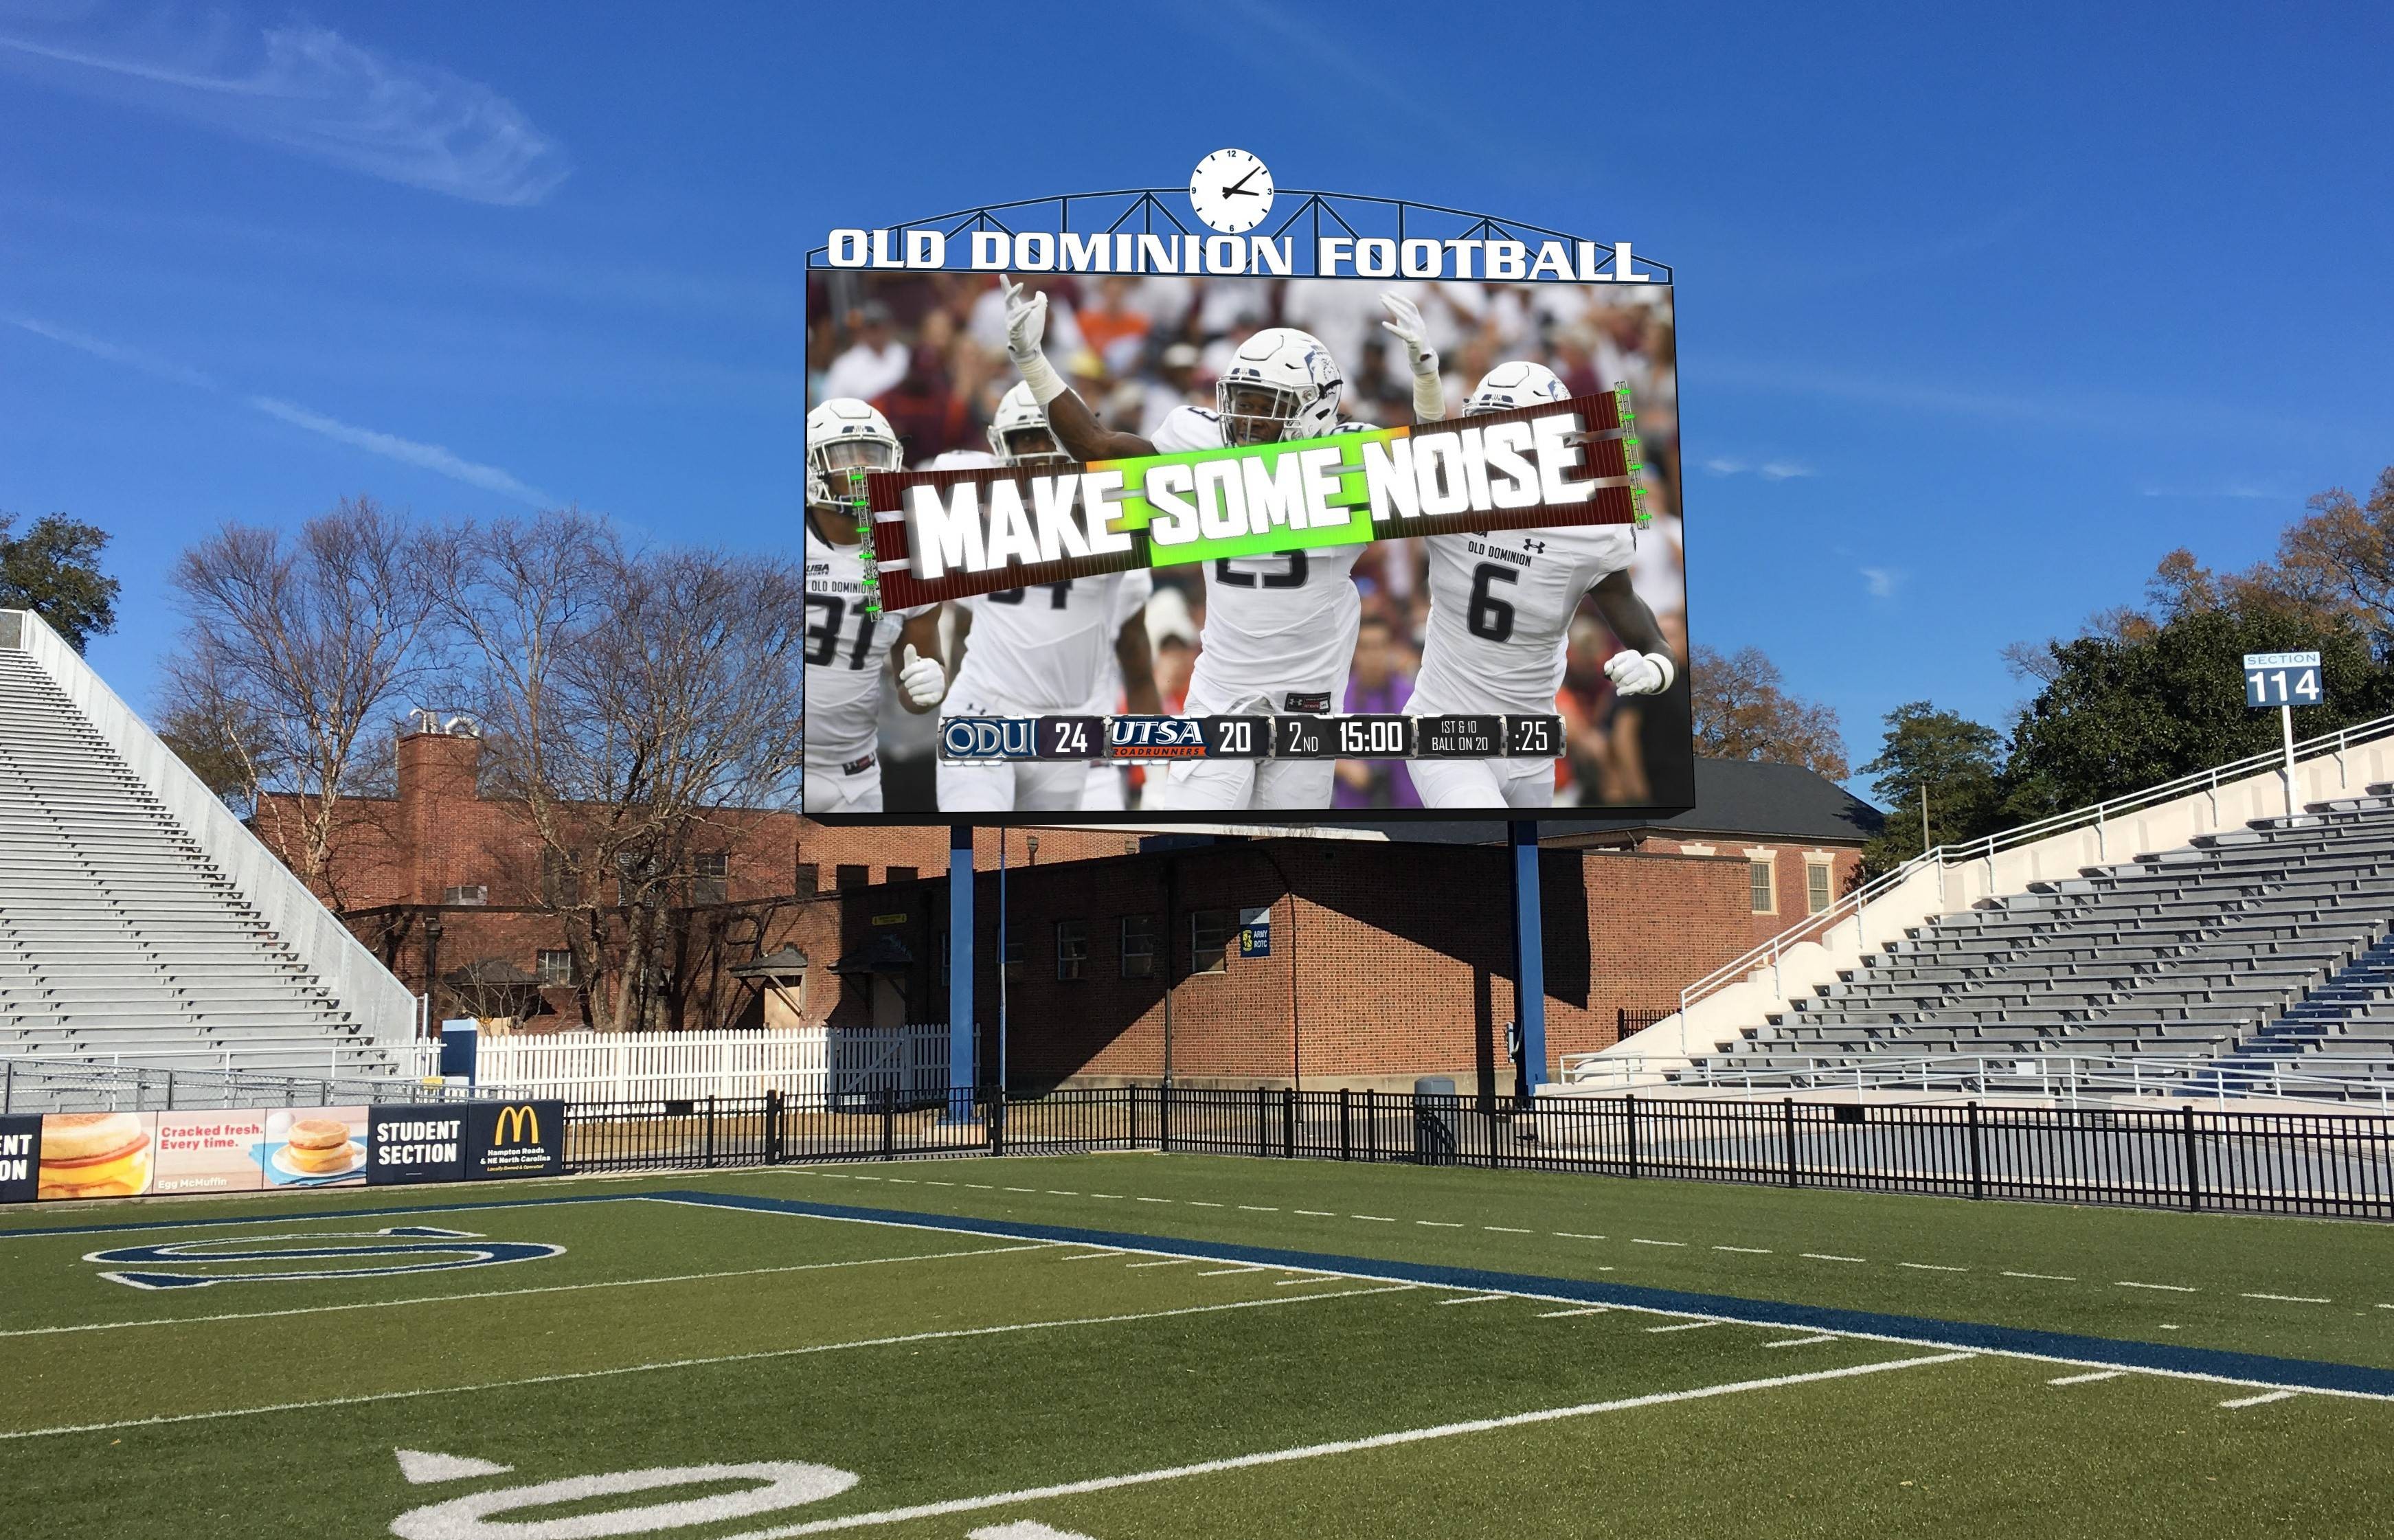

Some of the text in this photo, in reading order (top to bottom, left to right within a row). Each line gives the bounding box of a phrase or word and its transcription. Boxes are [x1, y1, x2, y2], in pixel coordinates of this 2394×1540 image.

[828, 228, 1651, 282] OLD DOMINION FOOTBALL
[902, 412, 1596, 580] MAKE SOME NOISE
[1468, 541, 1532, 567] OLD DOMINION
[811, 580, 869, 594] OLD DOMINIO
[1467, 561, 1520, 644] 6
[805, 593, 877, 670] 31
[2248, 654, 2316, 665] SECTION
[2249, 670, 2320, 702] 114
[946, 722, 1028, 753] ODU
[1055, 723, 1088, 753] 24
[1111, 721, 1204, 745] UTSA
[1219, 722, 1251, 752] 20
[1289, 722, 1318, 752] 2ND
[1340, 722, 1403, 751] 15:00
[1441, 721, 1476, 733] 1ST & 10
[1515, 721, 1548, 751] :25
[1114, 747, 1199, 756] ROADRUNNERS
[1432, 737, 1488, 751] BALL ON 20
[1254, 930, 1268, 938] ARMY
[1254, 940, 1267, 948] ROTC
[161, 1124, 264, 1137] Cracked fresh.
[377, 1120, 461, 1142] STUDENT
[161, 1137, 239, 1151] Every time.
[379, 1142, 458, 1165] SECTION
[158, 1177, 227, 1189] Egg McMuffin
